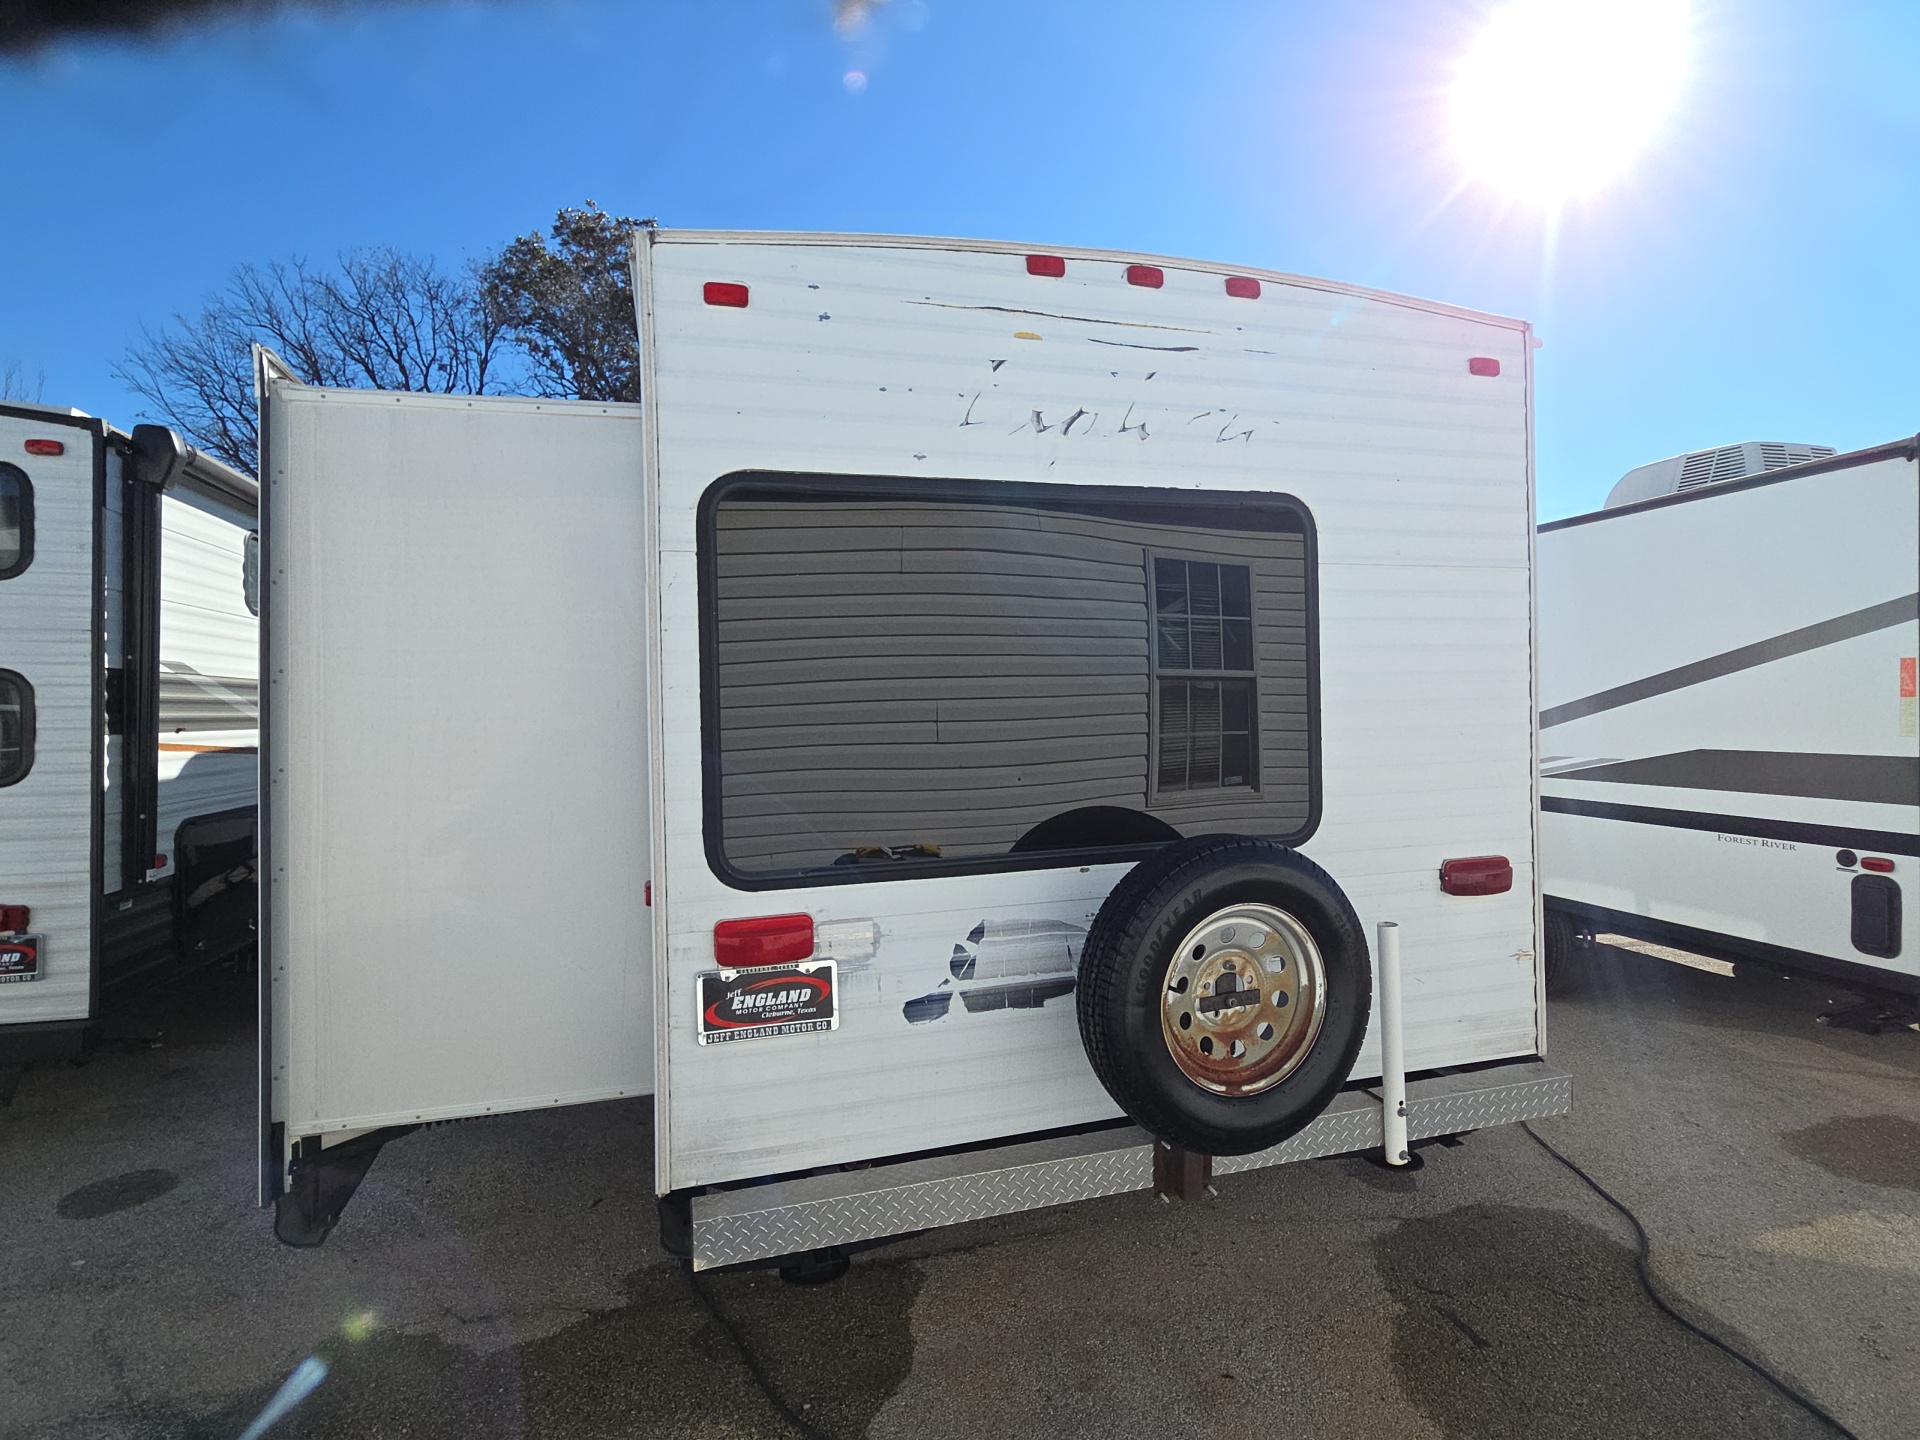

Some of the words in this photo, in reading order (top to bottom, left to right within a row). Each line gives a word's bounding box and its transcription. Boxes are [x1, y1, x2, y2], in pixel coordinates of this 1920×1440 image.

[1717, 834, 1759, 846] FOREST
[1761, 840, 1797, 851] RIVER
[1136, 888, 1202, 994] GOODYEAR
[726, 988, 742, 1000] Jeff
[731, 988, 812, 1010] ENGLAND
[735, 1006, 763, 1015] MOTOR
[765, 1002, 804, 1011] COMPANY
[797, 1006, 817, 1014] Texas
[707, 1032, 732, 1043] JEFF
[734, 1026, 779, 1040] ENGLAND
[781, 1022, 814, 1034] MOTOR
